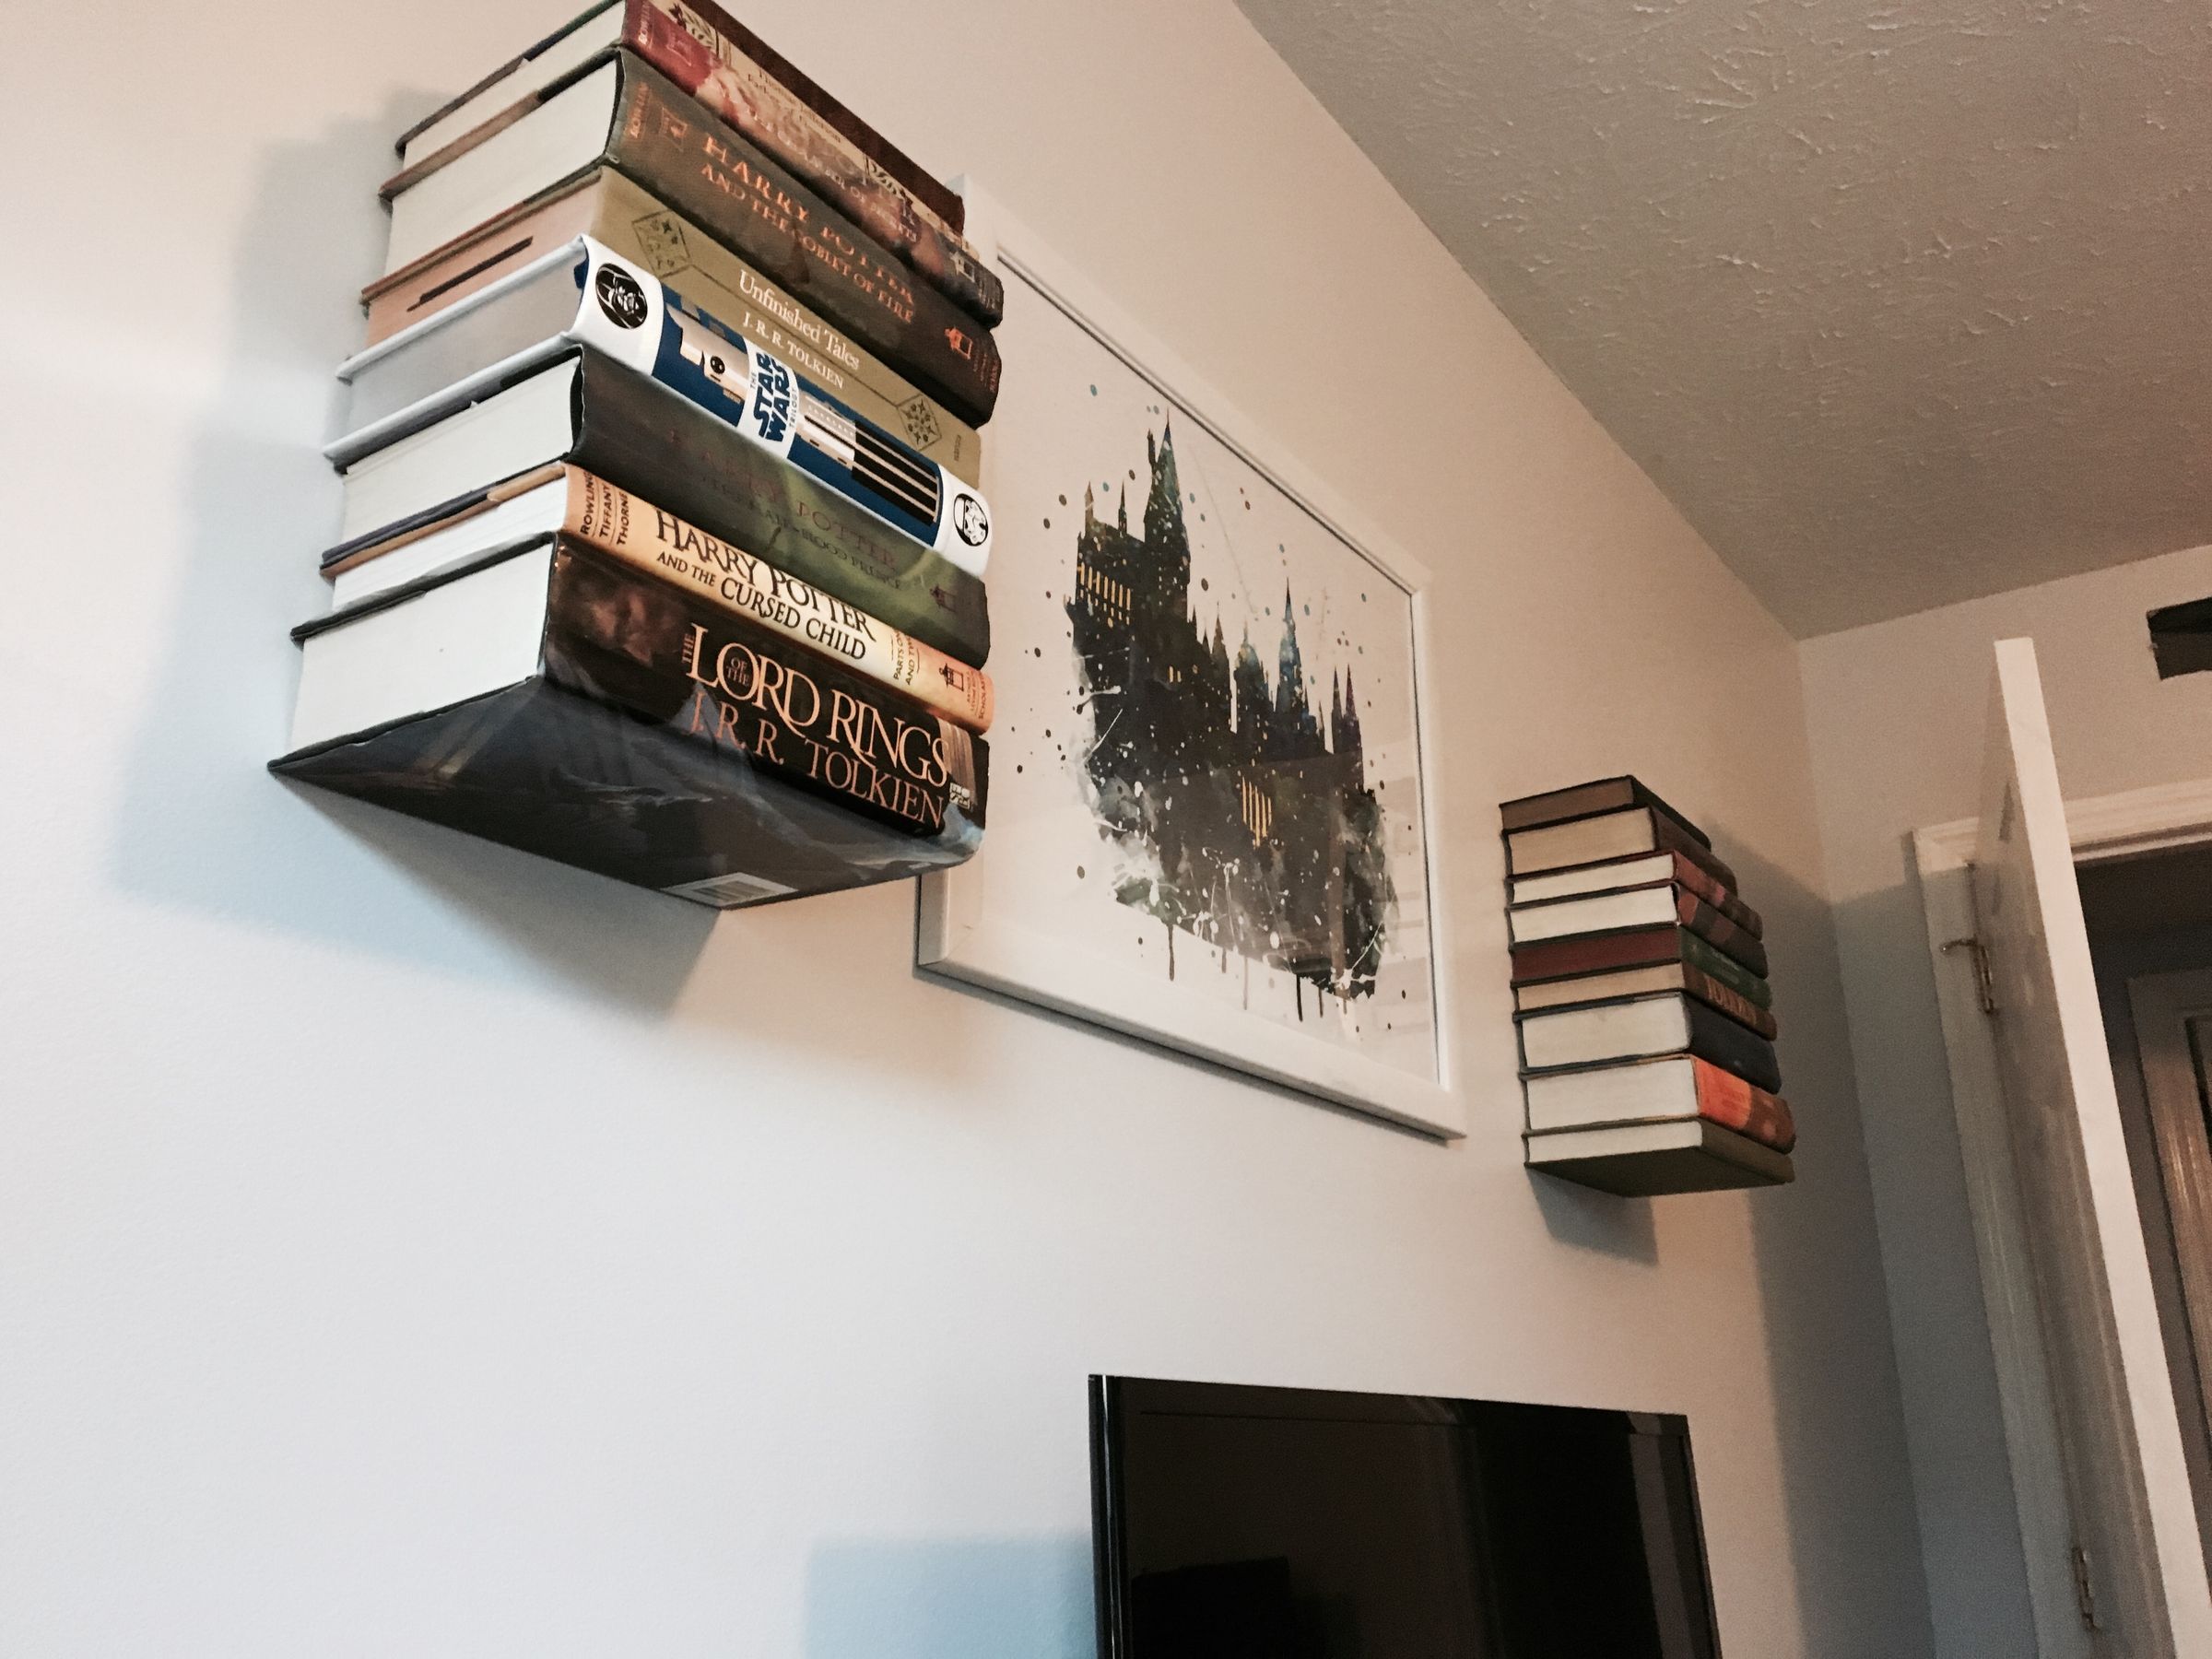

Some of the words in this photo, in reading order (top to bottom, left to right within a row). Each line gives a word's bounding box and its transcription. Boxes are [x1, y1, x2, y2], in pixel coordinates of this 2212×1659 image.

[702, 132, 810, 222] HARRY
[700, 163, 746, 201] AND
[751, 198, 788, 231] THE
[853, 273, 875, 294] OF
[878, 289, 914, 324] FIRE
[740, 269, 821, 344] Unfinished
[823, 329, 860, 371] Tales
[754, 352, 774, 438] STAR
[765, 356, 791, 442] WARS
[787, 340, 844, 389] TOLKIEN
[617, 490, 629, 546] THORNE
[656, 509, 759, 587] HARRY
[767, 561, 877, 643] POTTER
[656, 550, 689, 573] AND
[691, 563, 718, 587] THE
[720, 576, 802, 629] CURSED
[806, 618, 866, 661] CHILD
[681, 633, 695, 664] THE
[686, 622, 820, 738] LORD
[725, 665, 749, 688] THE
[730, 656, 747, 670] OF
[893, 647, 904, 680] PARTS
[905, 659, 915, 686] AND
[826, 688, 949, 788] RINGS
[804, 738, 945, 829] TOLKIEN
